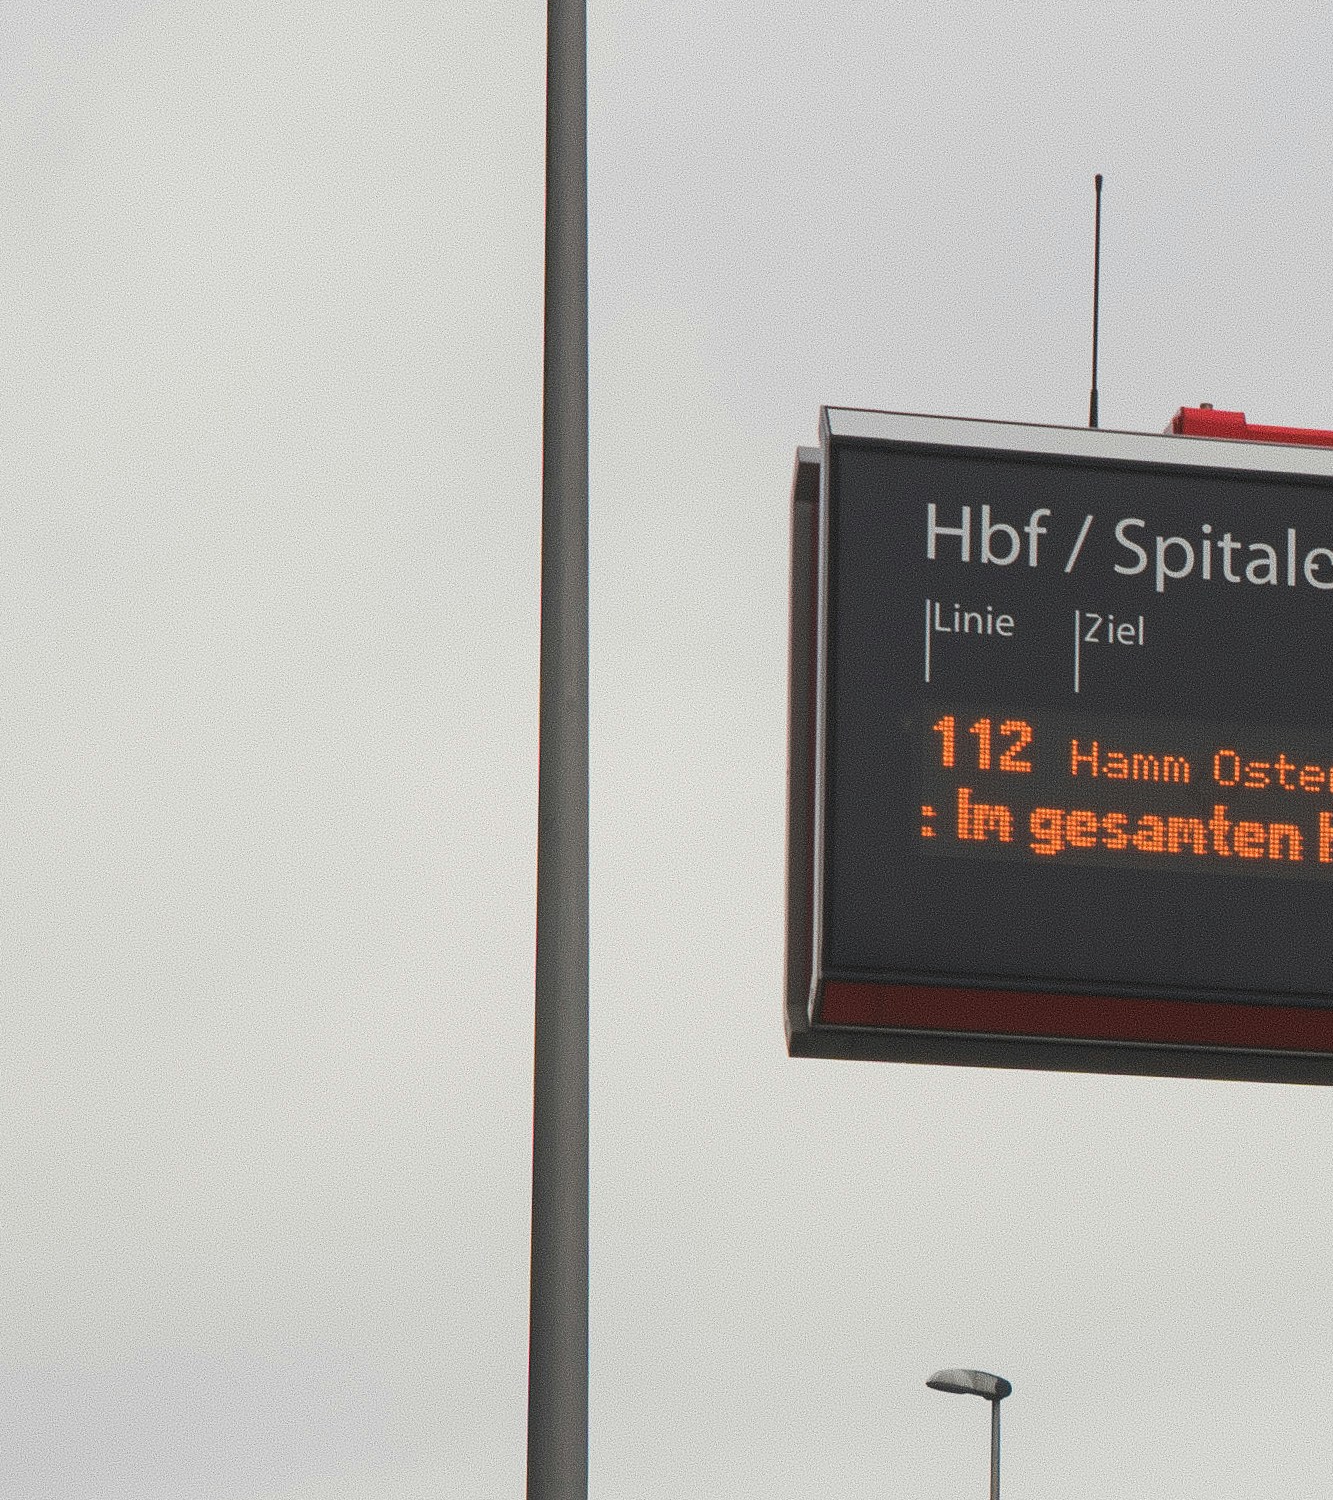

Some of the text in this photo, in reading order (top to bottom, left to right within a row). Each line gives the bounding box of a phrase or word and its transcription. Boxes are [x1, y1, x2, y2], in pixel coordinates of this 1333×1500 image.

[925, 502, 1051, 567] Hbf
[1064, 514, 1094, 573] /
[934, 604, 1015, 638] Linie
[1083, 612, 1145, 647] Ziel
[932, 715, 1034, 774] 112
[1070, 739, 1191, 785] Hamm
[956, 786, 1015, 844] Im
[1029, 804, 1304, 863] gesamten
